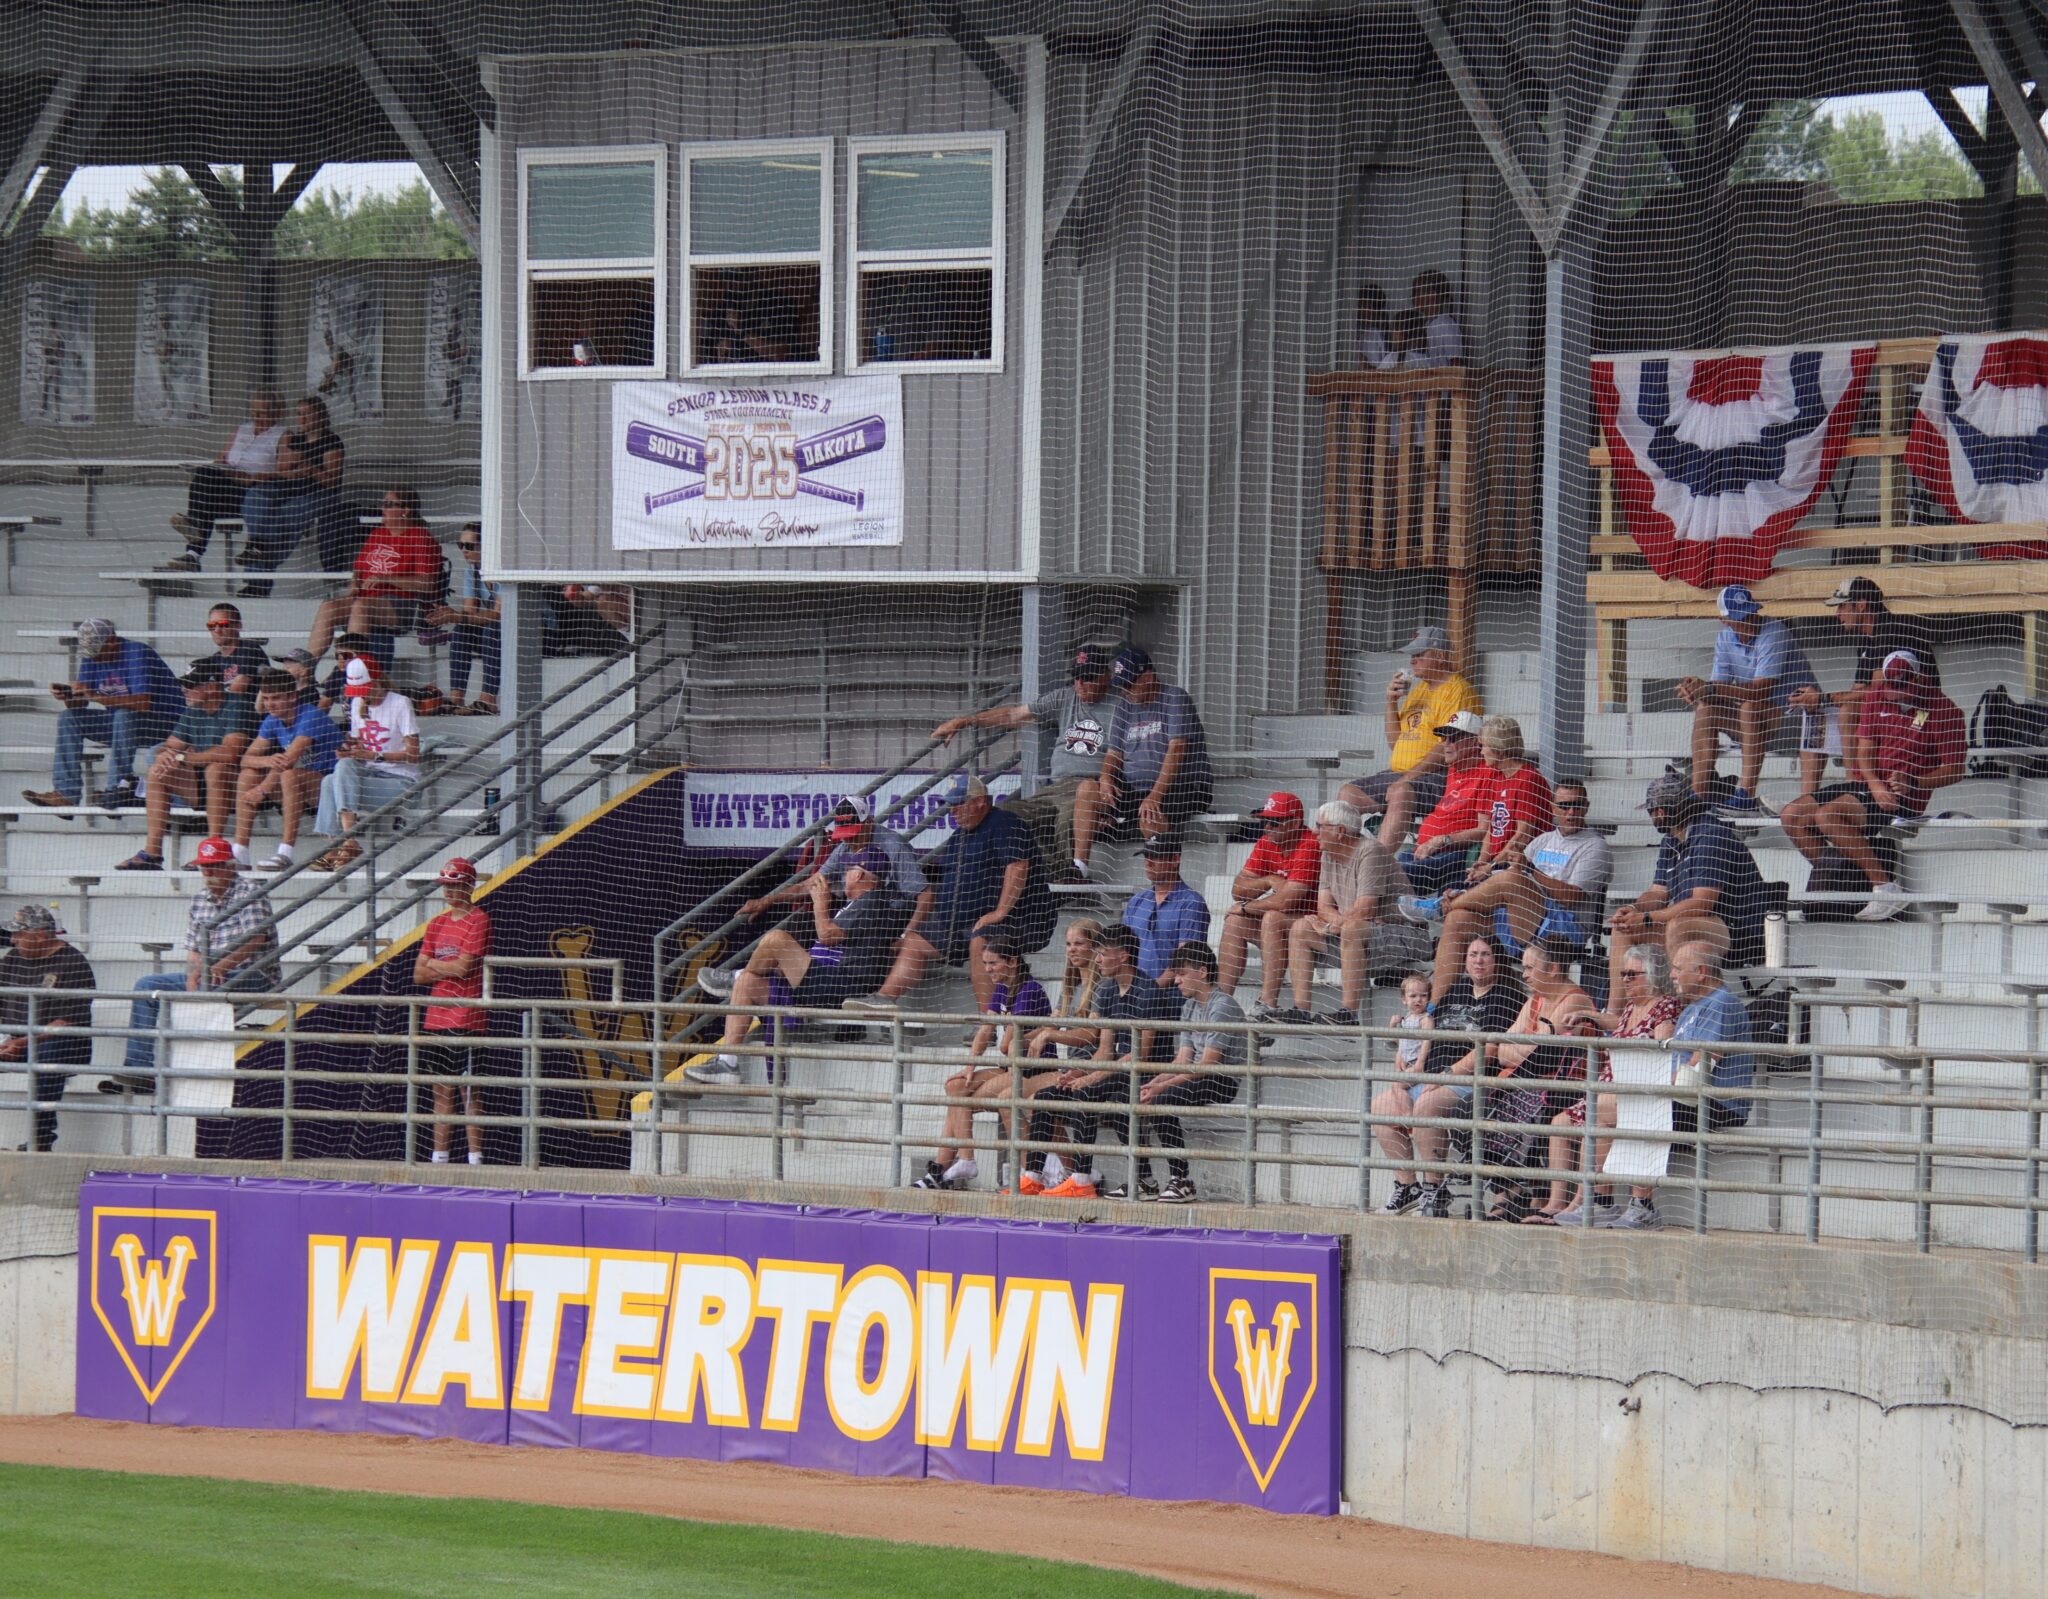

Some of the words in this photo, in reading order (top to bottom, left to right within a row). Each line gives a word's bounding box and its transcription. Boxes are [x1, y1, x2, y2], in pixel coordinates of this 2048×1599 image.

[667, 391, 715, 417] SENIOR
[719, 389, 771, 405] LEGION
[772, 390, 819, 411] CLASS
[819, 398, 832, 414] A
[704, 408, 731, 422] STATE
[732, 406, 794, 420] TOURNAMENT
[647, 434, 697, 466] SOUTH
[704, 435, 798, 499] 2025
[802, 429, 866, 467] DAKOTA
[853, 522, 884, 531] LEGION
[110, 1233, 197, 1346] W
[306, 1234, 1125, 1462] WATERTOWN
[1225, 1298, 1301, 1427] W
